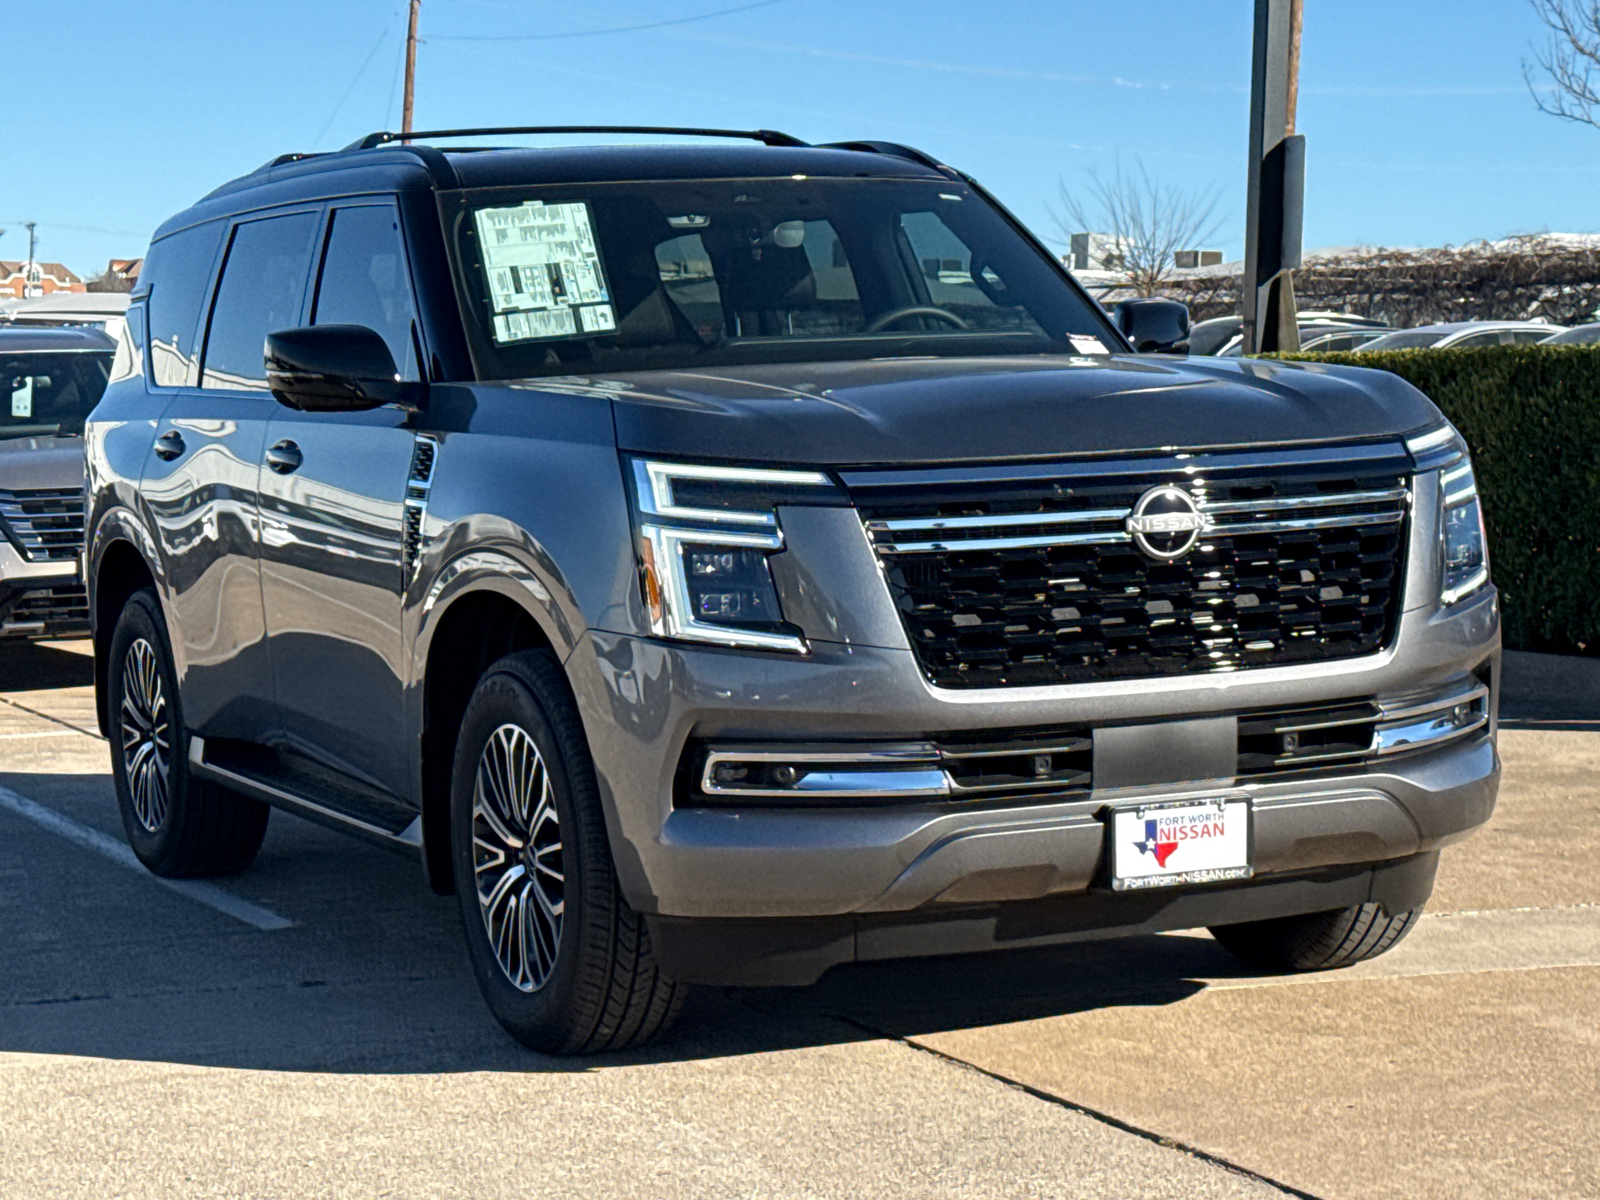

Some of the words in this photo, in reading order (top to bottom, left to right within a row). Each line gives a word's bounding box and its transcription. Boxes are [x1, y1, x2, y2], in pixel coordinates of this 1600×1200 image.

[1128, 515, 1205, 531] NISSAN
[1159, 815, 1185, 826] FORT
[1188, 812, 1225, 824] WORTH
[1159, 821, 1225, 842] NISSAN
